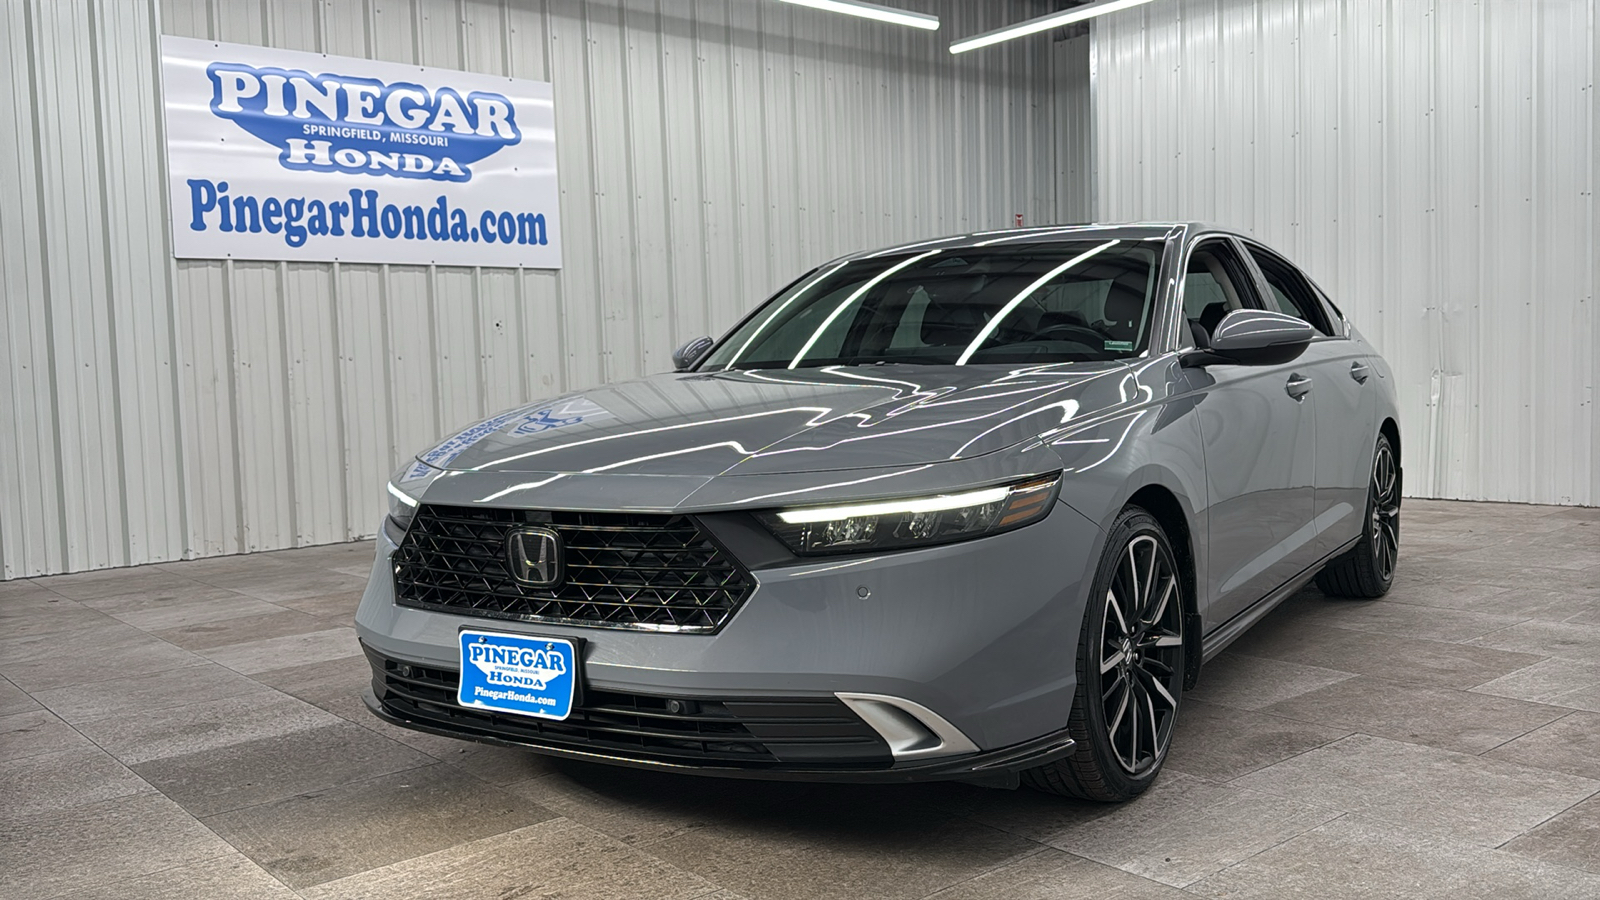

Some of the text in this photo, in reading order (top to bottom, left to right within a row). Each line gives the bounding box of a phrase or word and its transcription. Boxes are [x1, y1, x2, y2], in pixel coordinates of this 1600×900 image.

[214, 69, 517, 140] PINEGAR
[302, 123, 449, 147] SPRINGFIELD, MISSOURI
[285, 138, 467, 176] HONDA
[186, 178, 549, 248] PinegarHonda.com
[471, 645, 564, 672] PINEGAR
[489, 671, 545, 687] HONDA
[520, 668, 540, 676] MISSOURI
[474, 685, 557, 706] PinegarHonda.com
